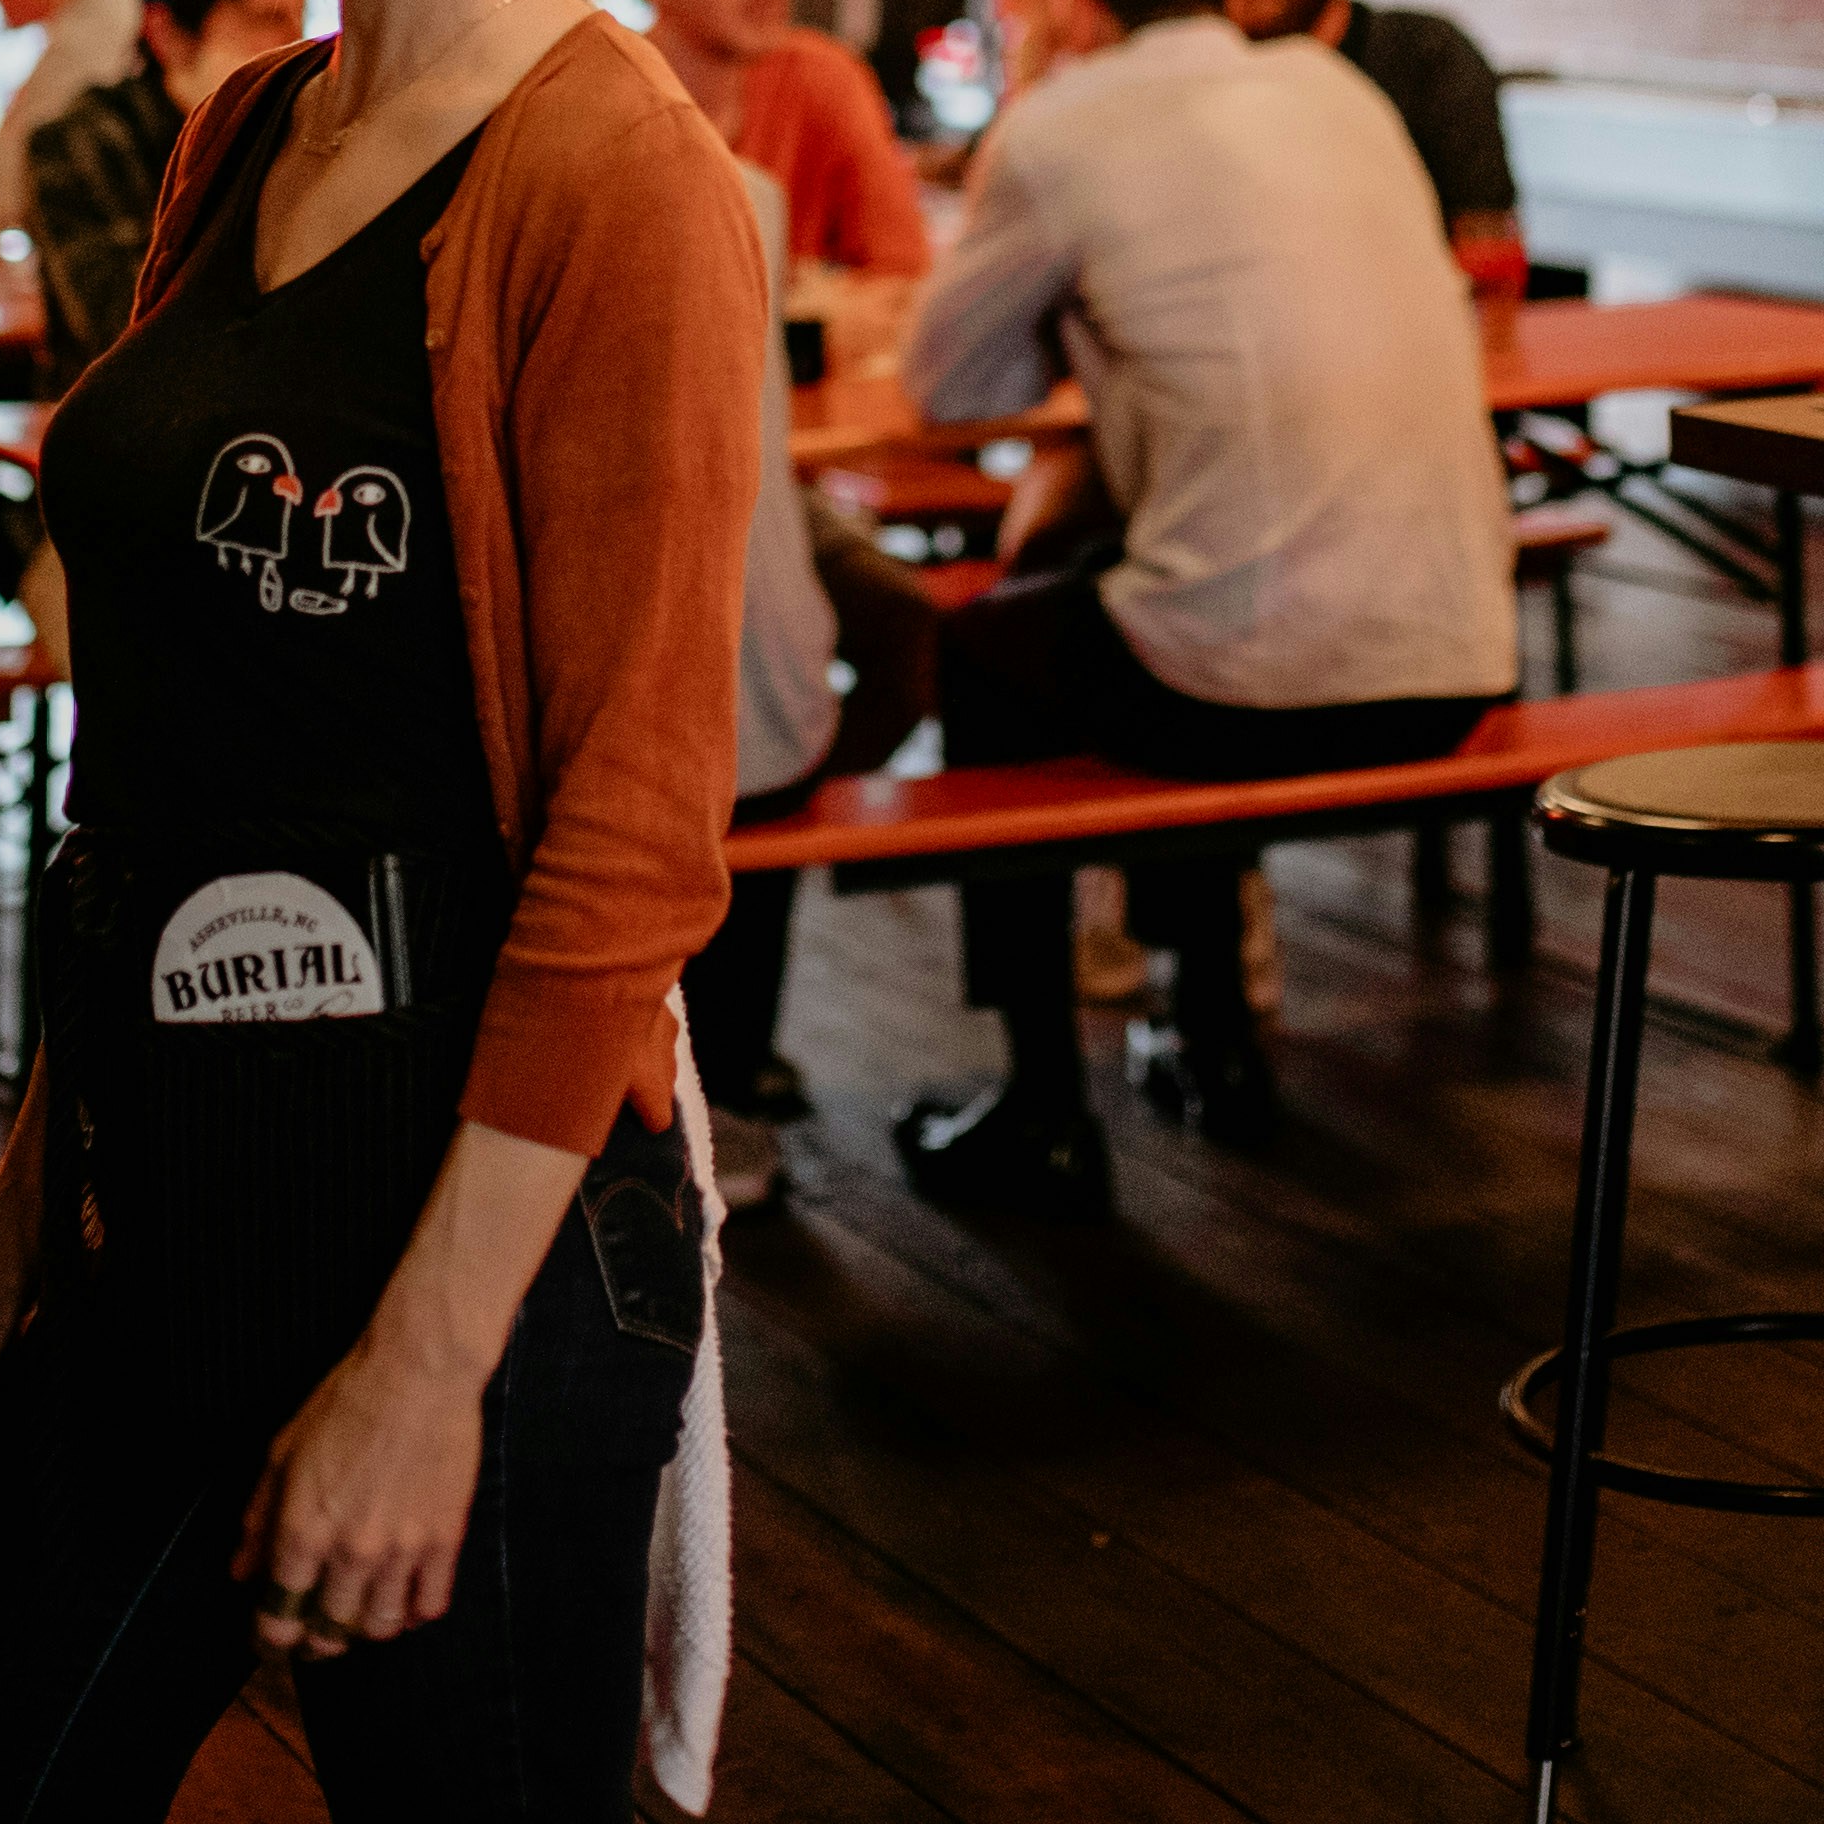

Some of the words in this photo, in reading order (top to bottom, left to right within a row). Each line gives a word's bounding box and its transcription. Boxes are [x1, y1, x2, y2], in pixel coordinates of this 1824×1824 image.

[188, 905, 288, 951] ASHEVILLE,
[294, 910, 318, 934] NC
[161, 942, 362, 1013] BURIAL
